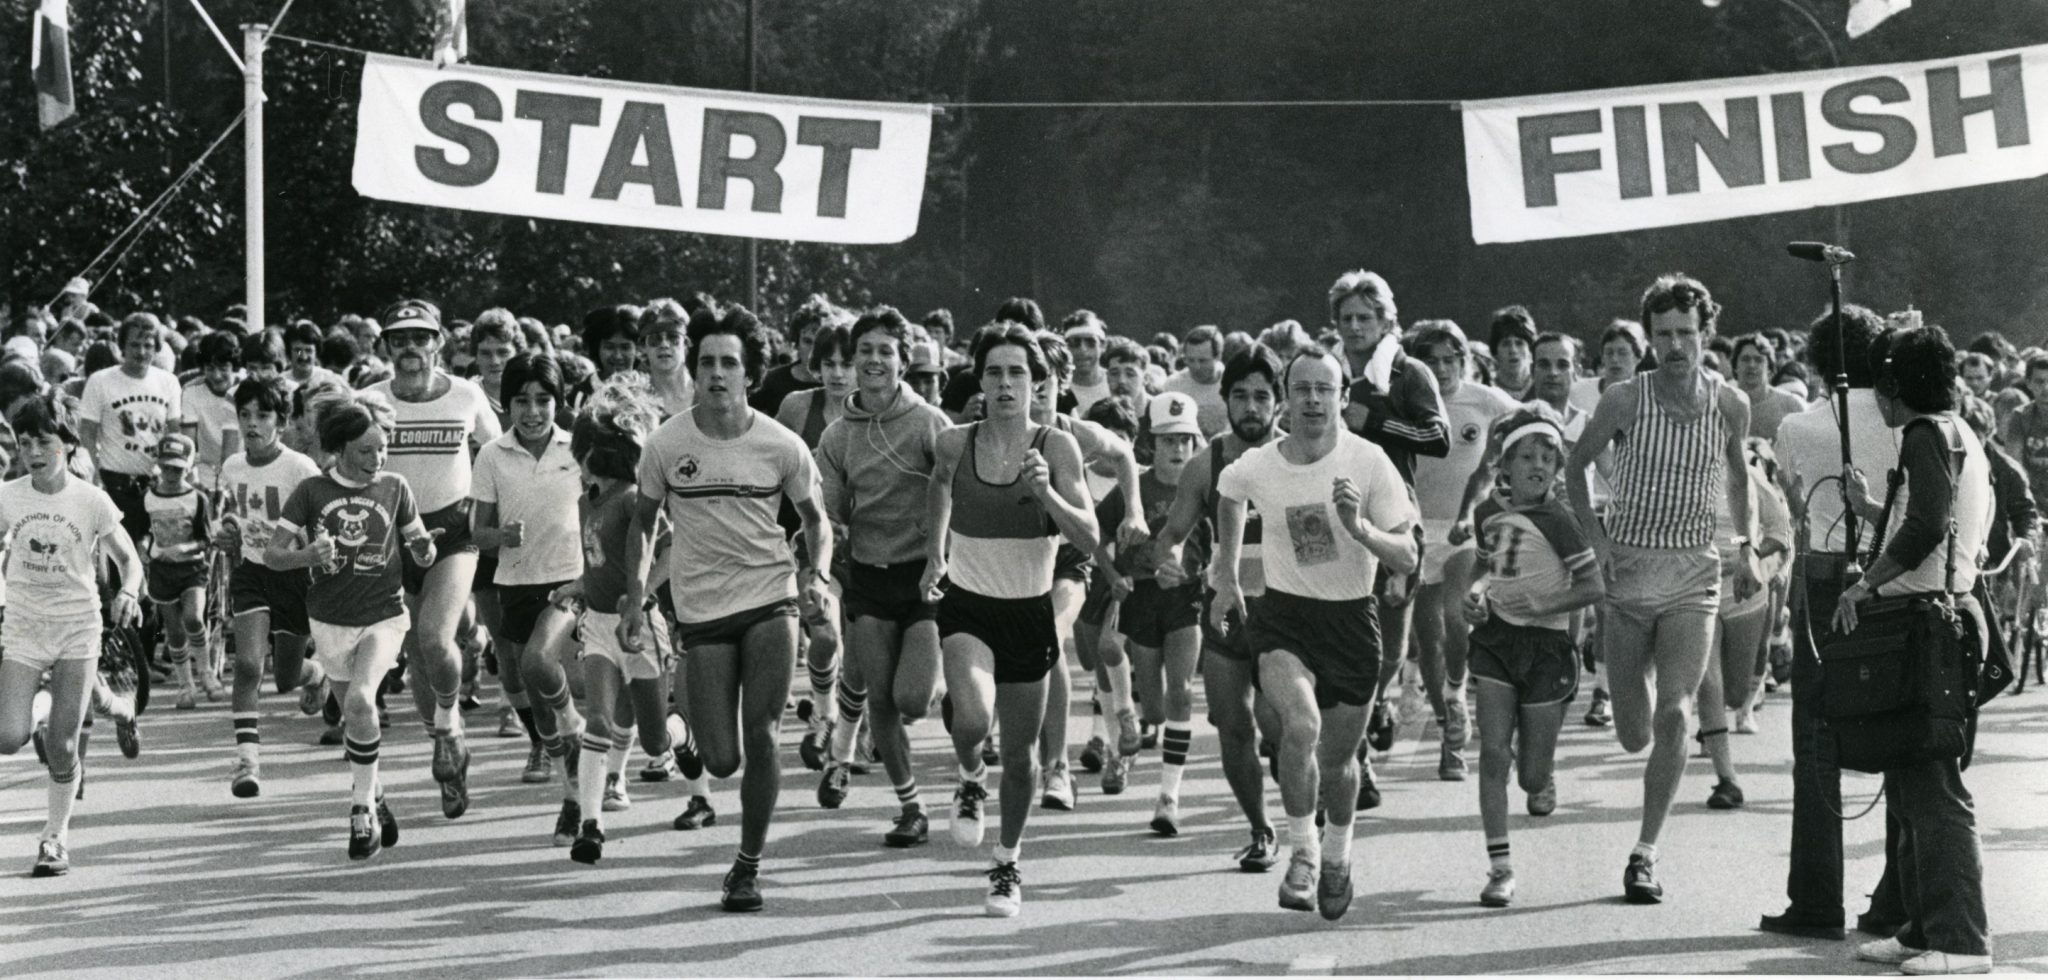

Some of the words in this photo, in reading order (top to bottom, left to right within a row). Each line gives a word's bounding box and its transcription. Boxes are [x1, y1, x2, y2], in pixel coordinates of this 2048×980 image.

[413, 79, 882, 219] START
[1517, 53, 2031, 209] FINISH
[22, 560, 49, 573] TERRY
[52, 564, 67, 573] FO
